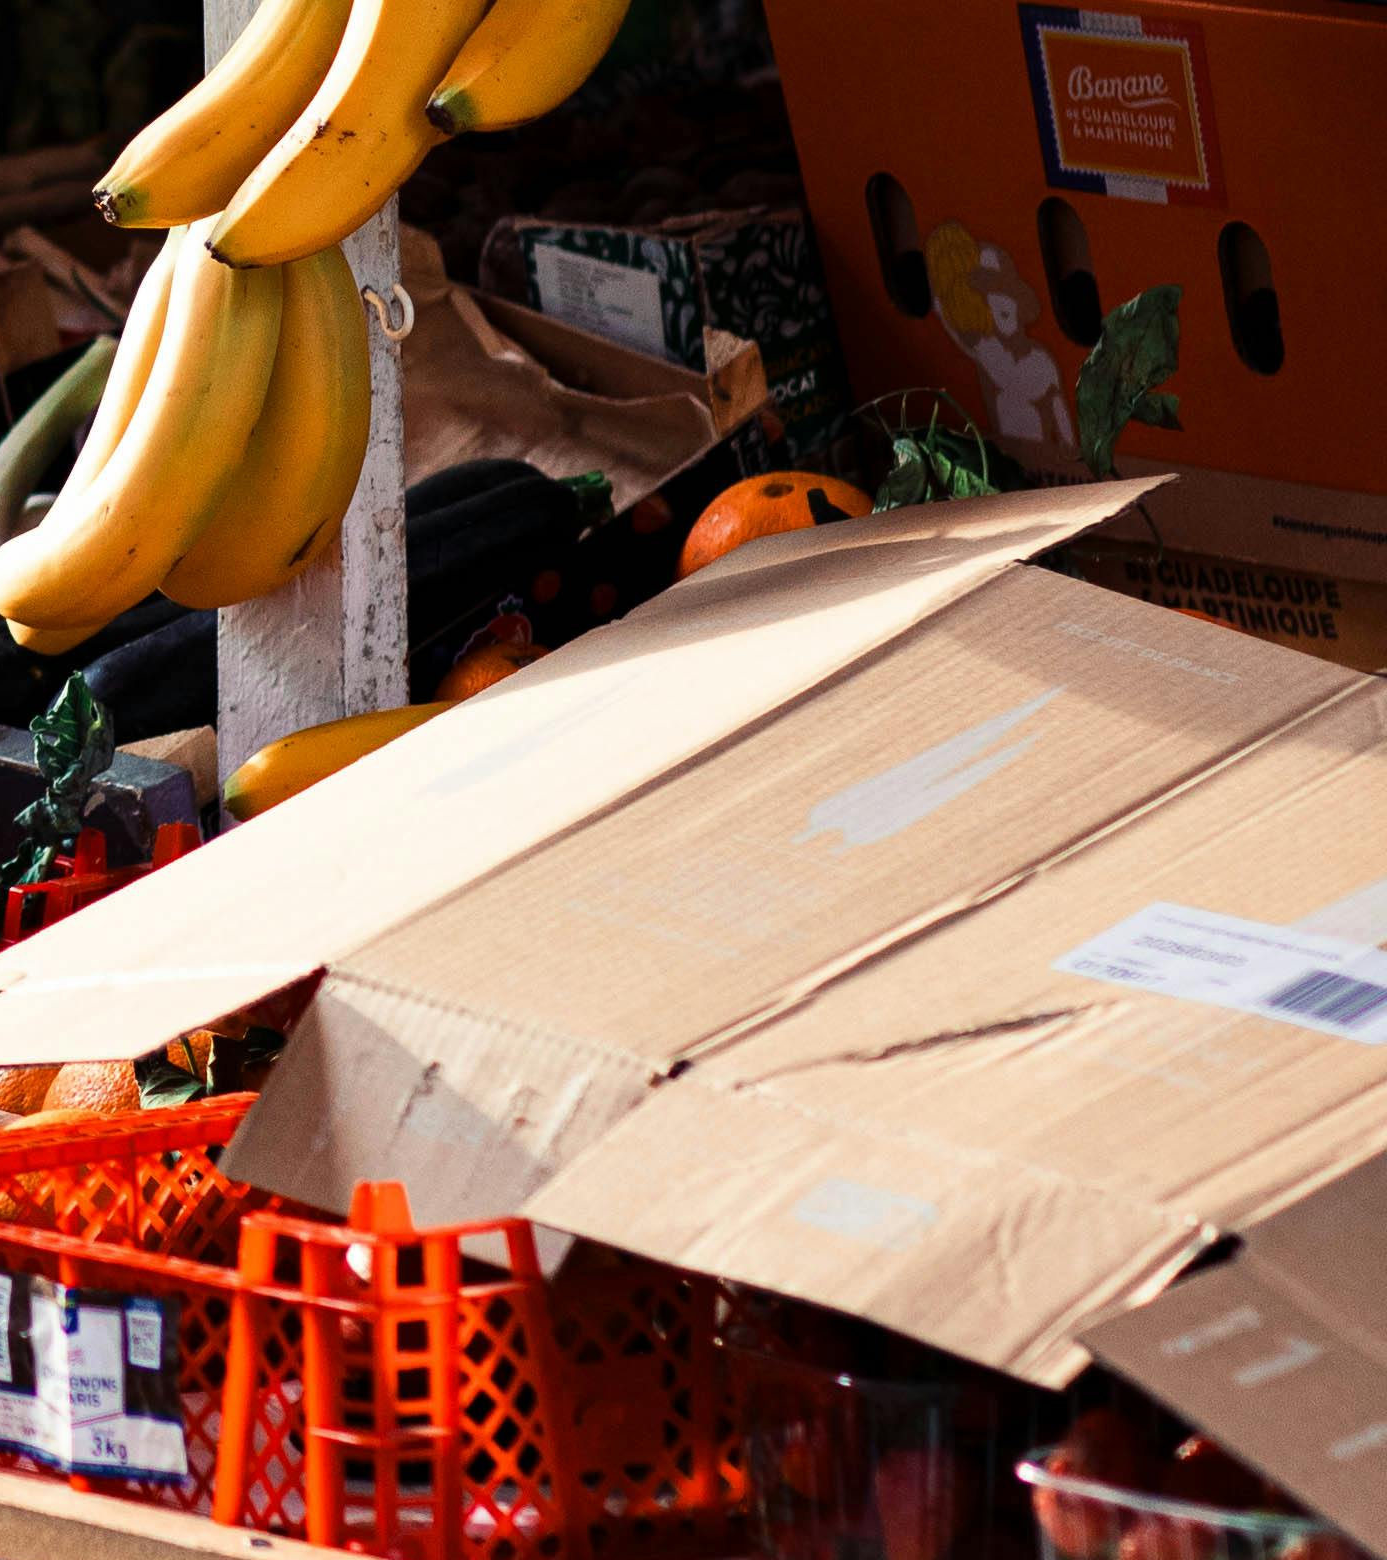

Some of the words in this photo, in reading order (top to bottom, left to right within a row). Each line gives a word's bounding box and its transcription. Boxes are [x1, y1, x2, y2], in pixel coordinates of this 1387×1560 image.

[1066, 63, 1180, 110] Banane
[1081, 105, 1177, 132] GUADELOUPE
[1084, 125, 1175, 152] MARTINIQUE
[1157, 559, 1342, 610] GUADELOUPE
